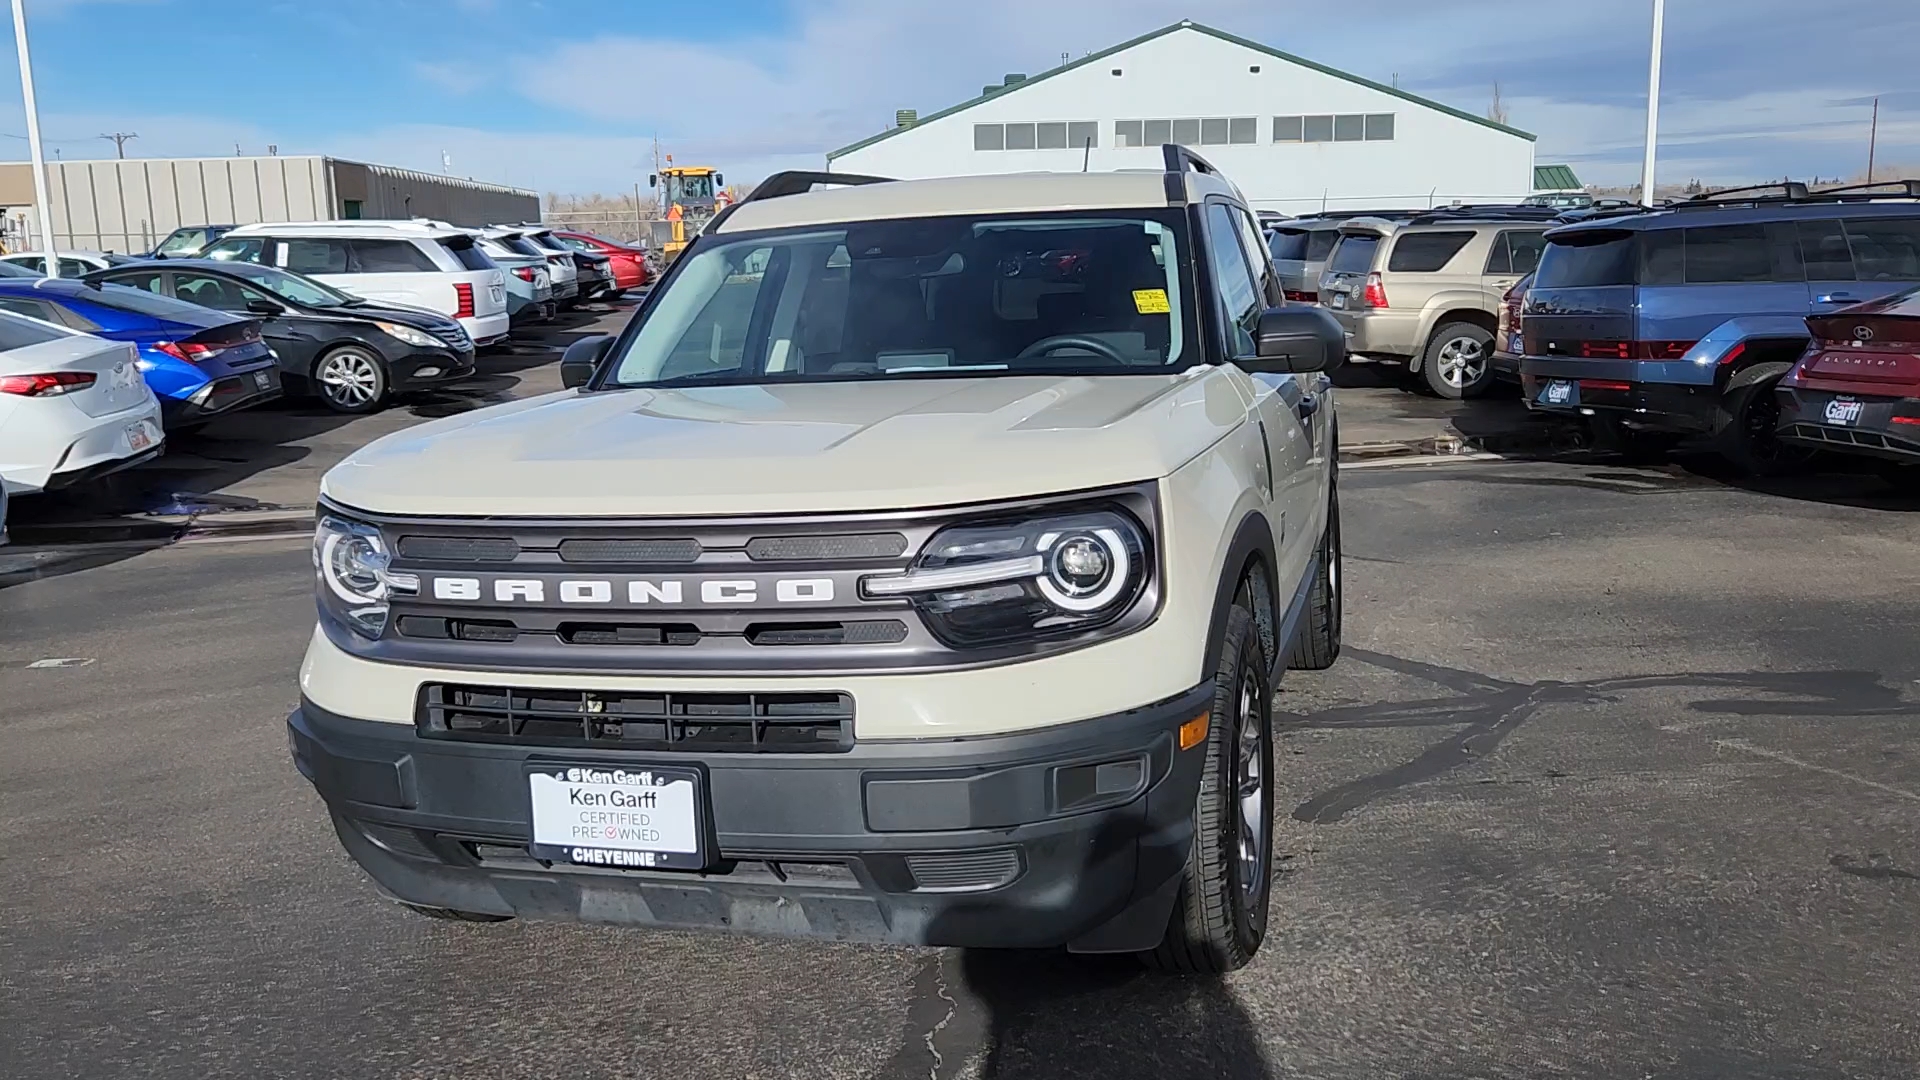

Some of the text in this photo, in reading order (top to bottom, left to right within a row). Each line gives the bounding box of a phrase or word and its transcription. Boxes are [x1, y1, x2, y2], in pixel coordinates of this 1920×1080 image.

[1825, 400, 1861, 420] Garff
[433, 577, 834, 604] BRONCO
[569, 788, 657, 808] Ken Garff
[579, 811, 650, 826] CERTIFIED
[572, 847, 656, 867] CHEYENNE
